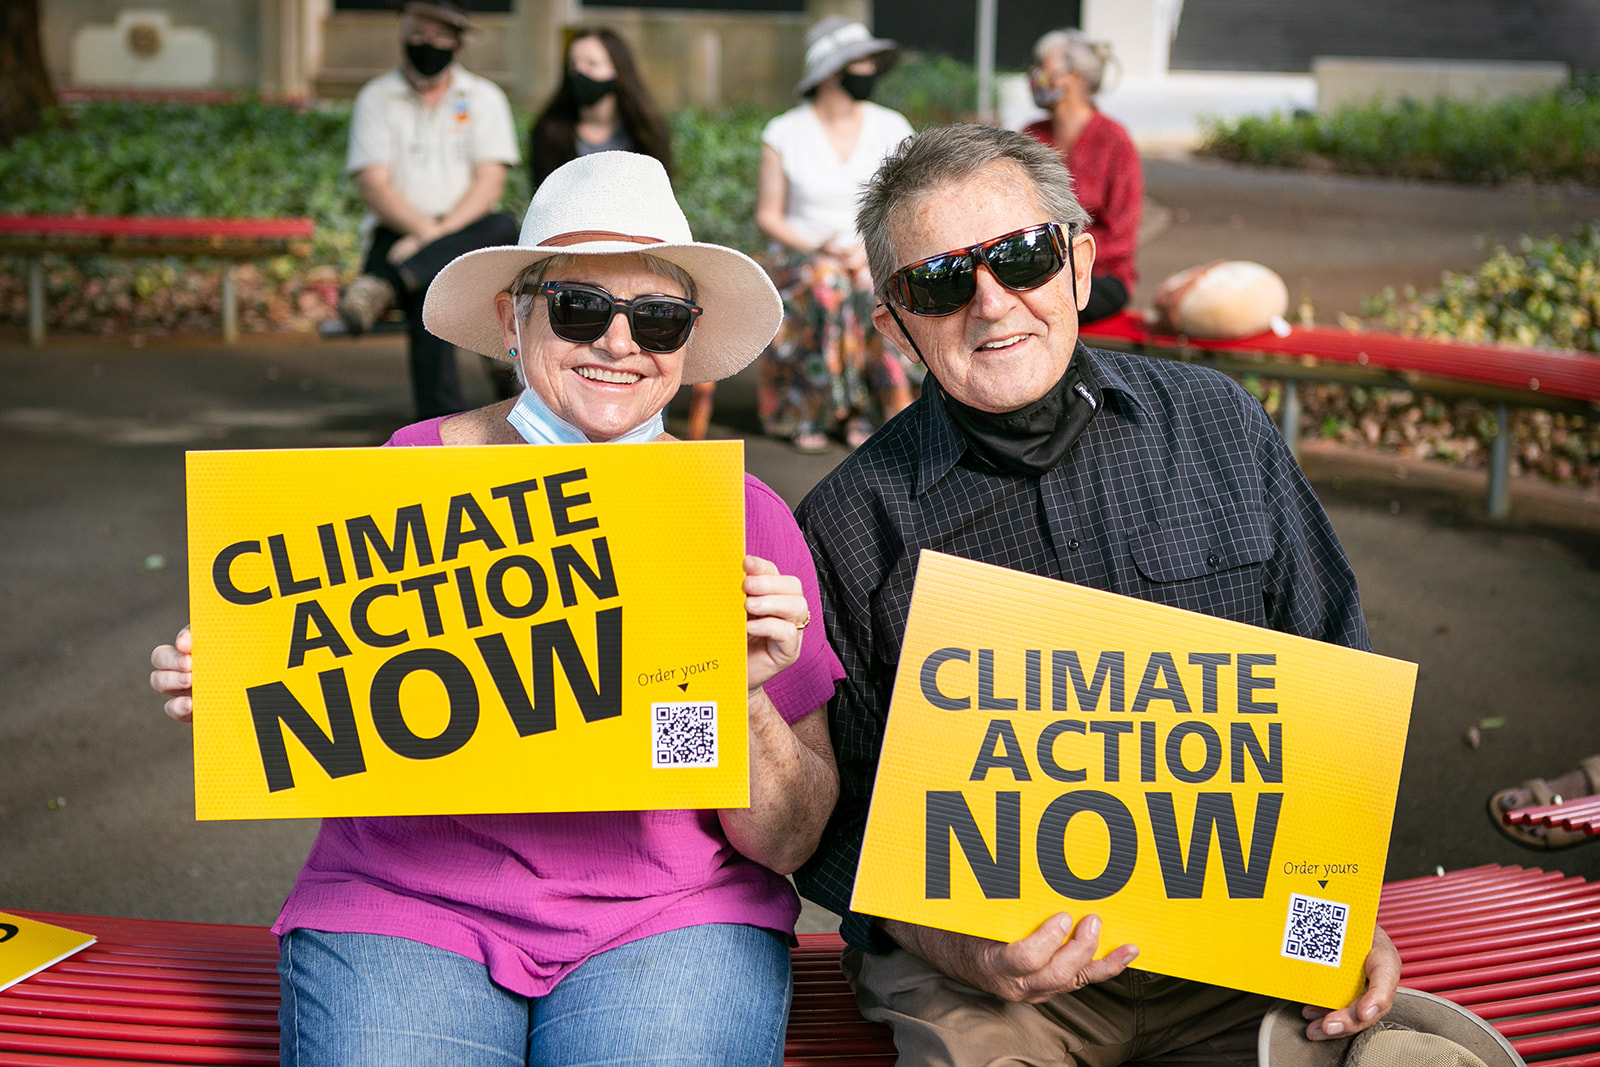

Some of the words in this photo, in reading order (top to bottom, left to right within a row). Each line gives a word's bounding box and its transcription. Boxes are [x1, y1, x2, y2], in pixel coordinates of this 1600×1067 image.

[213, 468, 600, 605] CLIMATE
[288, 536, 619, 669] ACTION
[246, 607, 623, 793] NOW
[637, 668, 676, 687] Order
[681, 659, 719, 681] yours
[920, 647, 1278, 713] CLIMATE
[970, 719, 1283, 784] ACTION
[925, 790, 1284, 900] NOW
[1283, 861, 1320, 875] Order
[1323, 863, 1359, 878] yours
